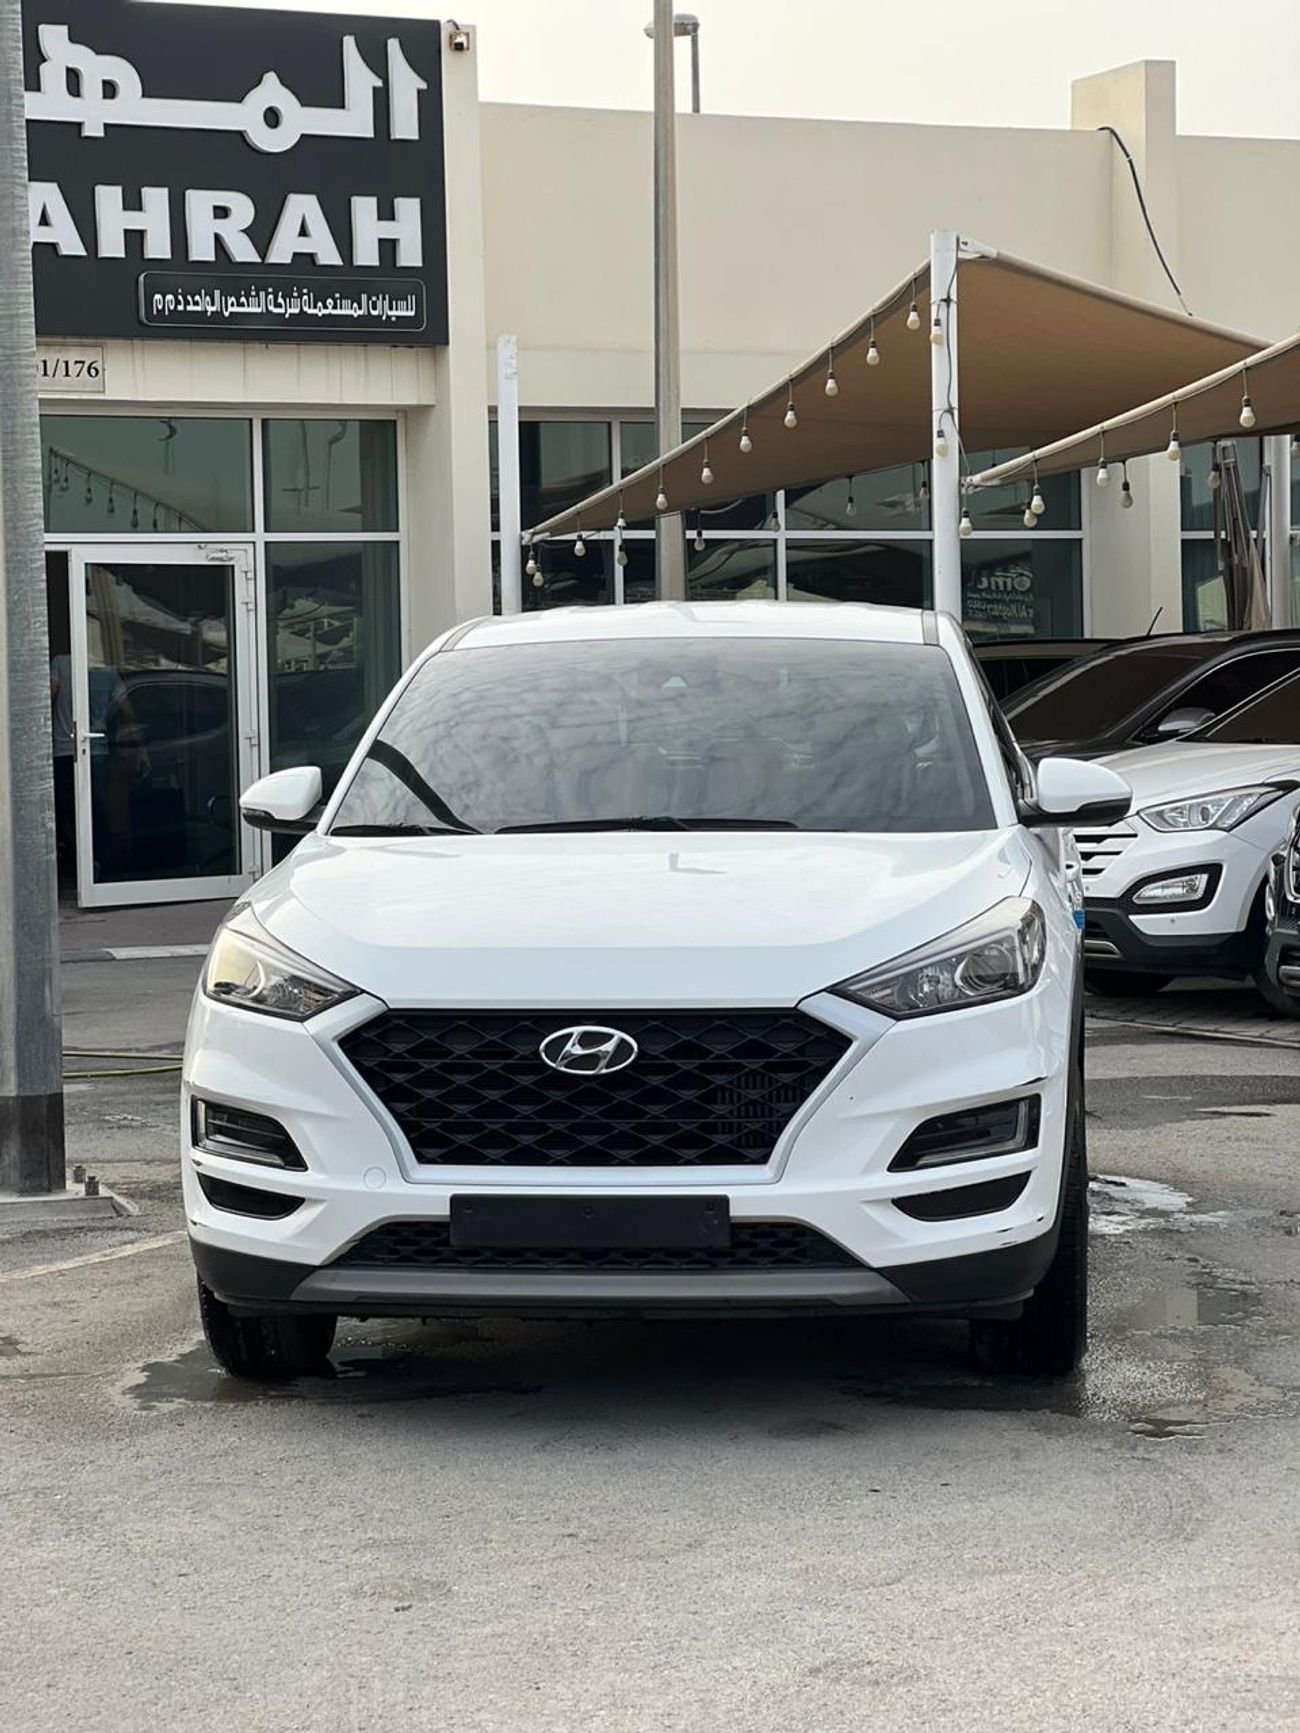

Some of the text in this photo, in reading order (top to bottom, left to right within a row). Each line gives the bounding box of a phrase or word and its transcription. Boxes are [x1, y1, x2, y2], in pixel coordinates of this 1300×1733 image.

[25, 24, 428, 153] المه
[29, 182, 423, 267] AHRAH
[186, 288, 221, 317] الواحد
[221, 285, 266, 317] الشخص
[267, 286, 301, 319] شركة
[302, 288, 368, 318] المستعملة
[368, 293, 416, 321] للسيارات
[39, 358, 100, 379] 1/176
